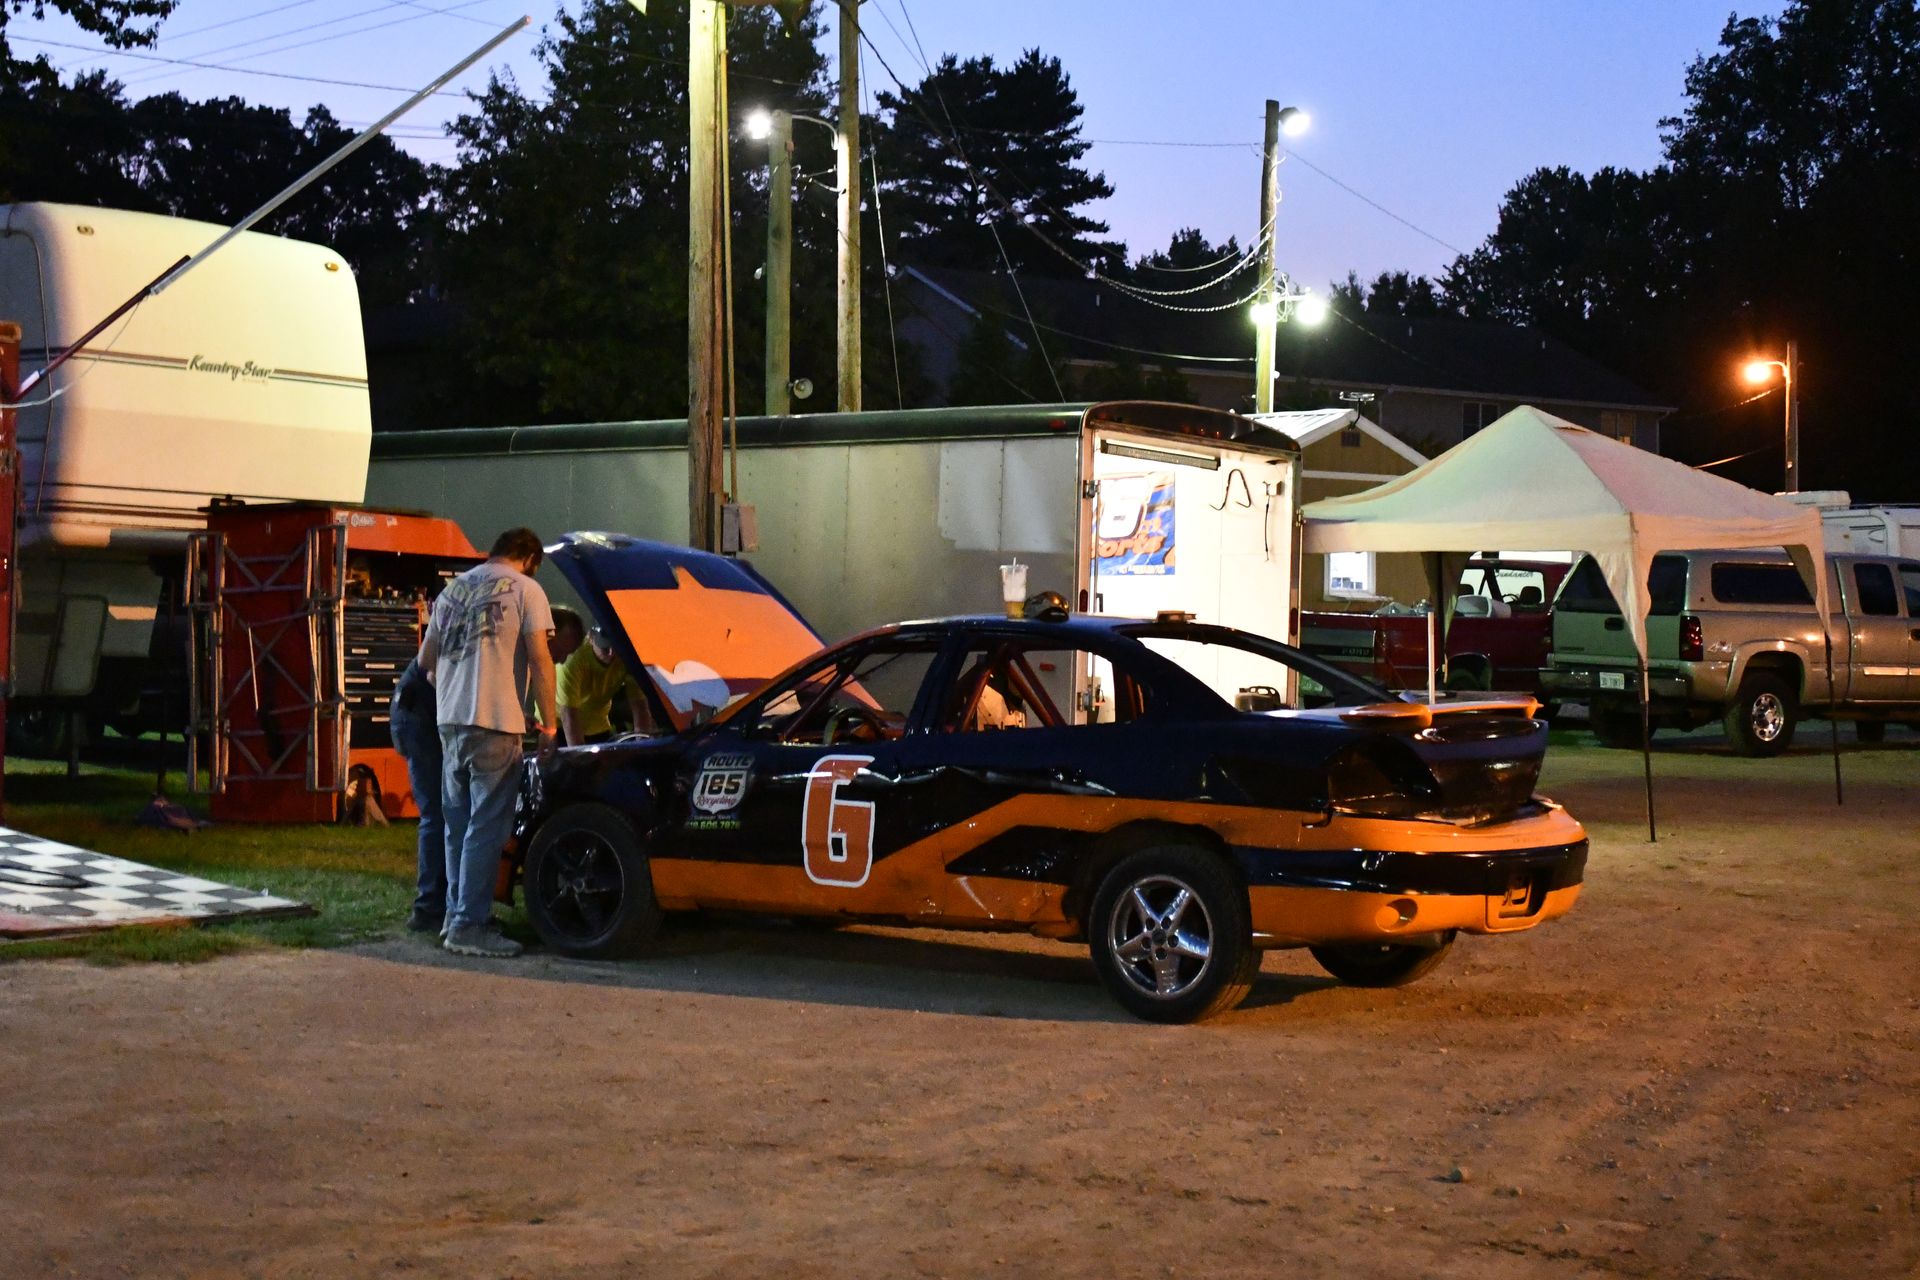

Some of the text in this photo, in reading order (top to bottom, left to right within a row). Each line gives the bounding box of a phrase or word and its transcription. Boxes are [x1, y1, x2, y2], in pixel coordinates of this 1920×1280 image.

[241, 360, 272, 377] Star
[707, 753, 752, 767] ROUTE
[700, 774, 744, 795] 185
[801, 753, 876, 889] 6
